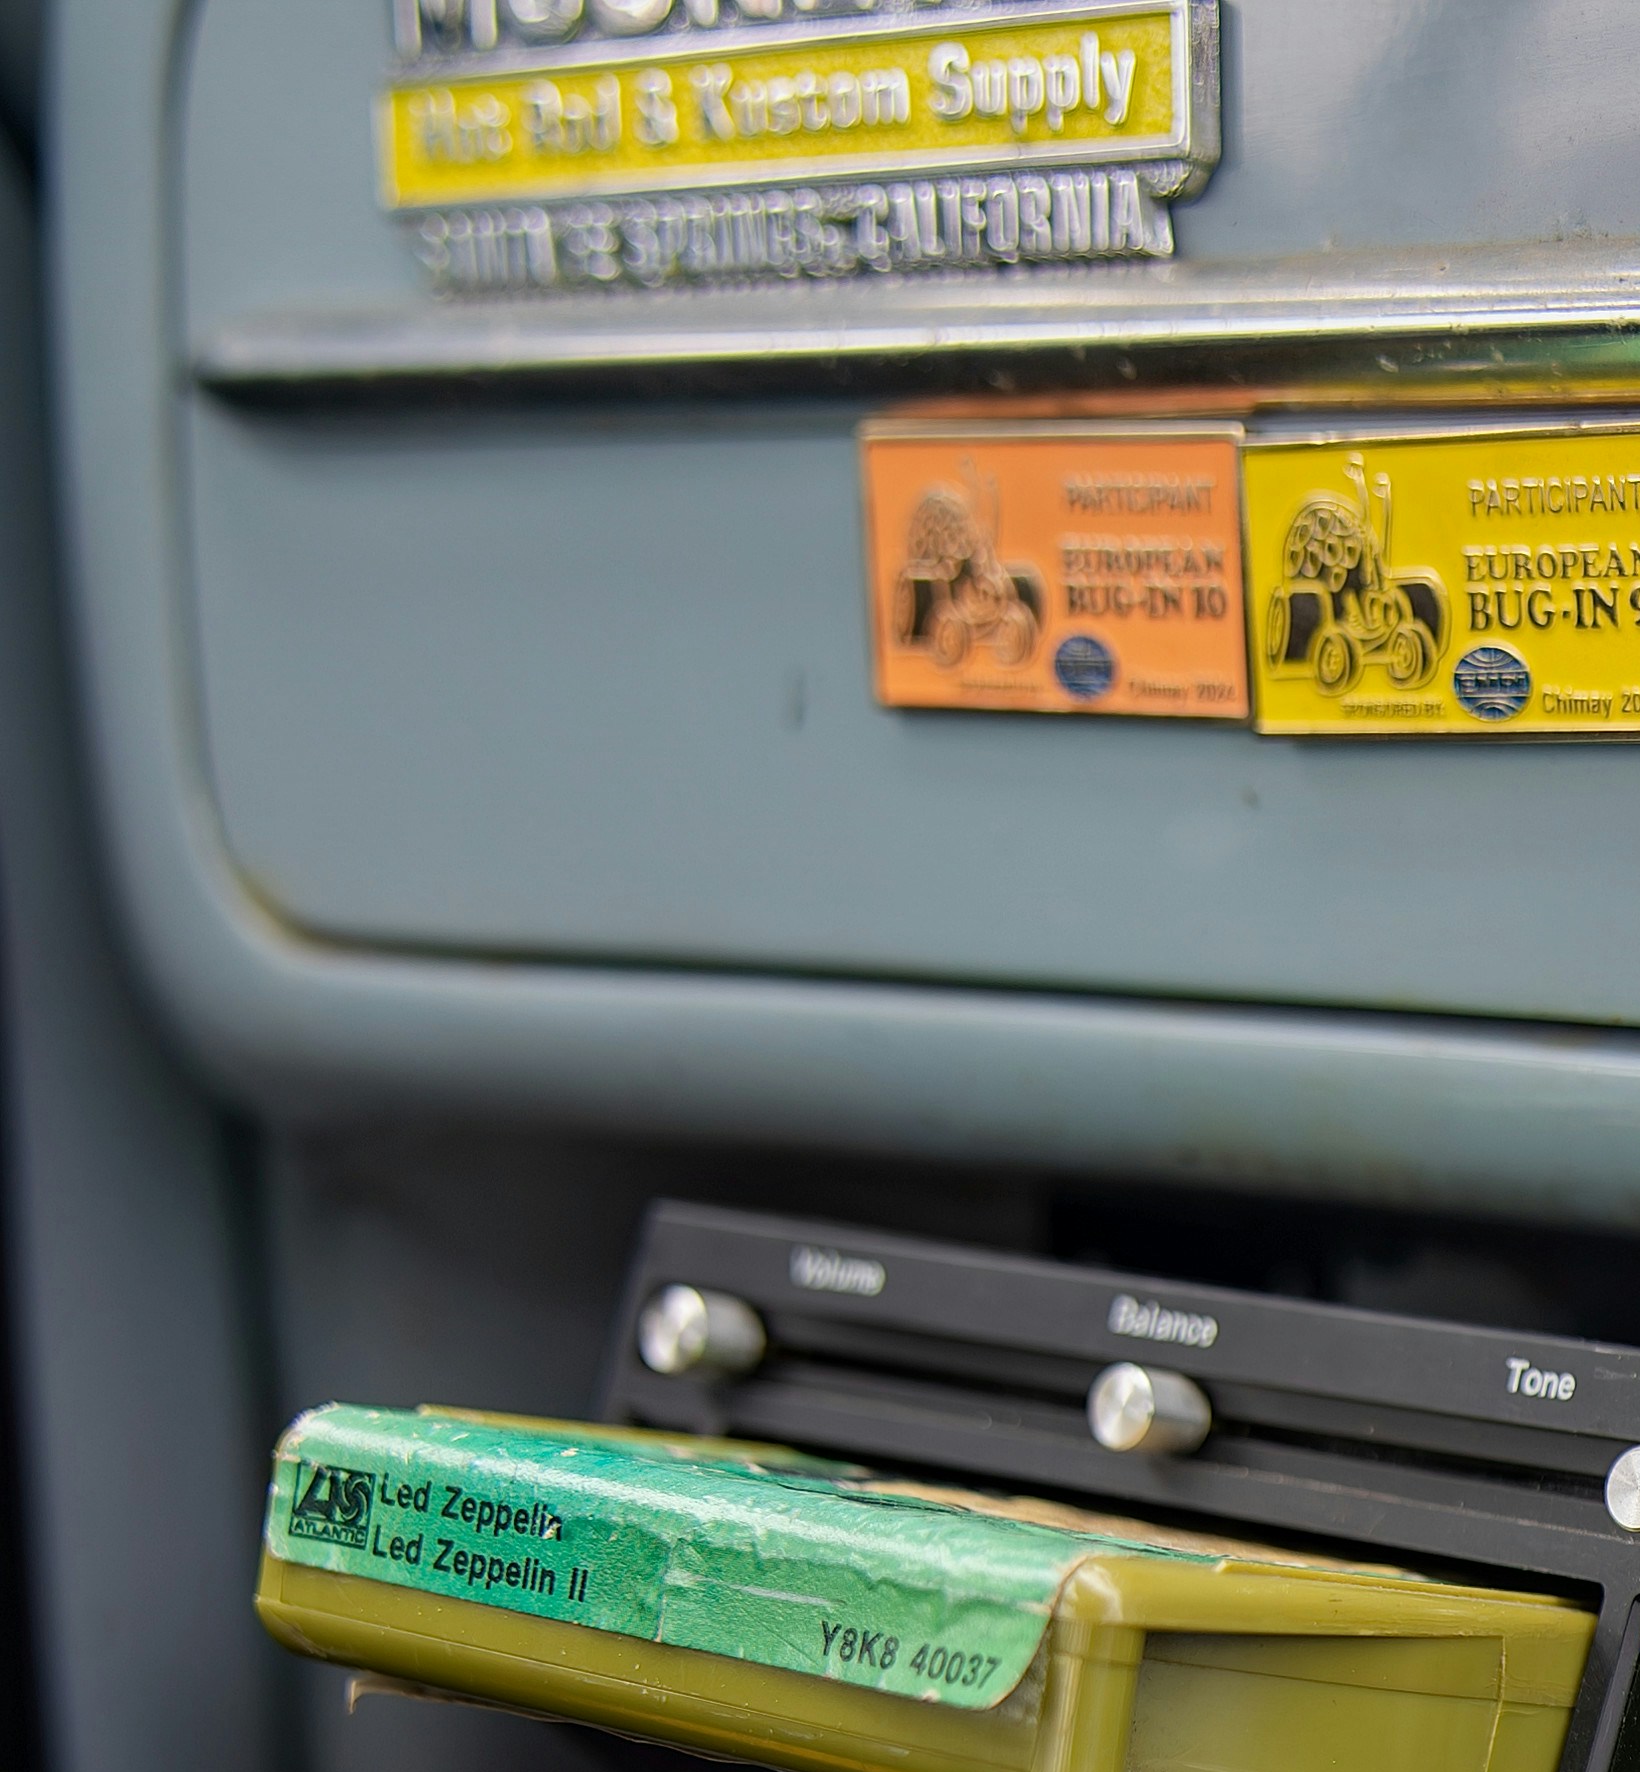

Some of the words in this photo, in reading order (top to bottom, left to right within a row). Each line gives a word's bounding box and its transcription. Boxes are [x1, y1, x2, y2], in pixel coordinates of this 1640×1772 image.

[929, 30, 1138, 133] Supply
[1468, 583, 1620, 632] BUG-IN
[1542, 685, 1613, 719] Chimay
[1108, 1294, 1219, 1348] Balance
[1506, 1357, 1577, 1401] Tone
[292, 1518, 366, 1546] ATLANTIC
[380, 1472, 432, 1513] Led
[441, 1486, 562, 1541] Zeppelin
[373, 1525, 424, 1566] Led
[433, 1538, 556, 1595] Zeppelin
[821, 1620, 900, 1670] Y8K8
[910, 1643, 1002, 1689] 40037
